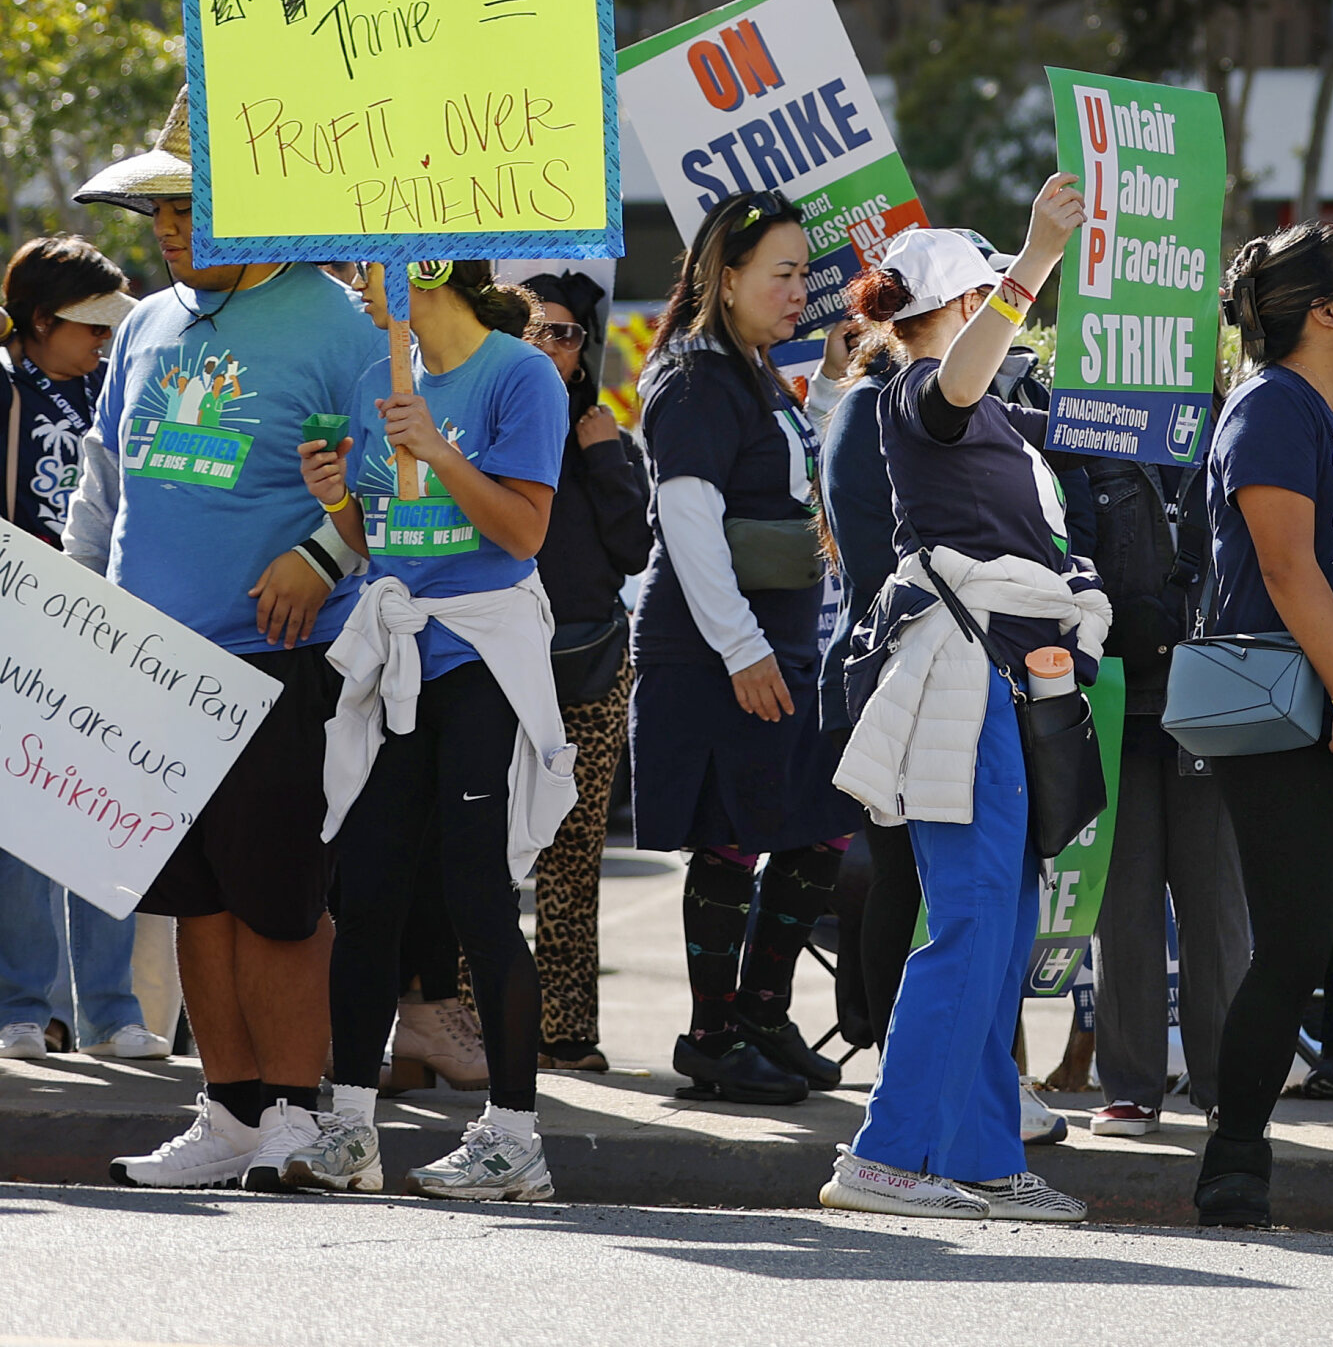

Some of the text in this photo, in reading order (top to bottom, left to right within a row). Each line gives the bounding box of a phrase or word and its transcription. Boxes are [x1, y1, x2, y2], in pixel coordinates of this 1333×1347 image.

[687, 18, 785, 113] ON
[236, 98, 393, 177] PROFIT
[682, 77, 873, 214] STRIKE
[348, 158, 575, 232] PATIENTS
[850, 214, 887, 250] ULP
[1081, 313, 1194, 387] STRIKE
[1057, 397, 1149, 430] #UNACUHCPstrong
[157, 430, 241, 462] TOGETHER
[1053, 424, 1139, 454] #TogetherWeWin
[33, 458, 79, 493] Sa
[149, 453, 235, 478] WE RISE WE WIN
[393, 505, 472, 527] TOGETHE
[390, 525, 474, 545] WE RISE WE WIN
[43, 593, 128, 655] offer
[130, 634, 188, 691] fair
[0, 657, 187, 794] Why are we
